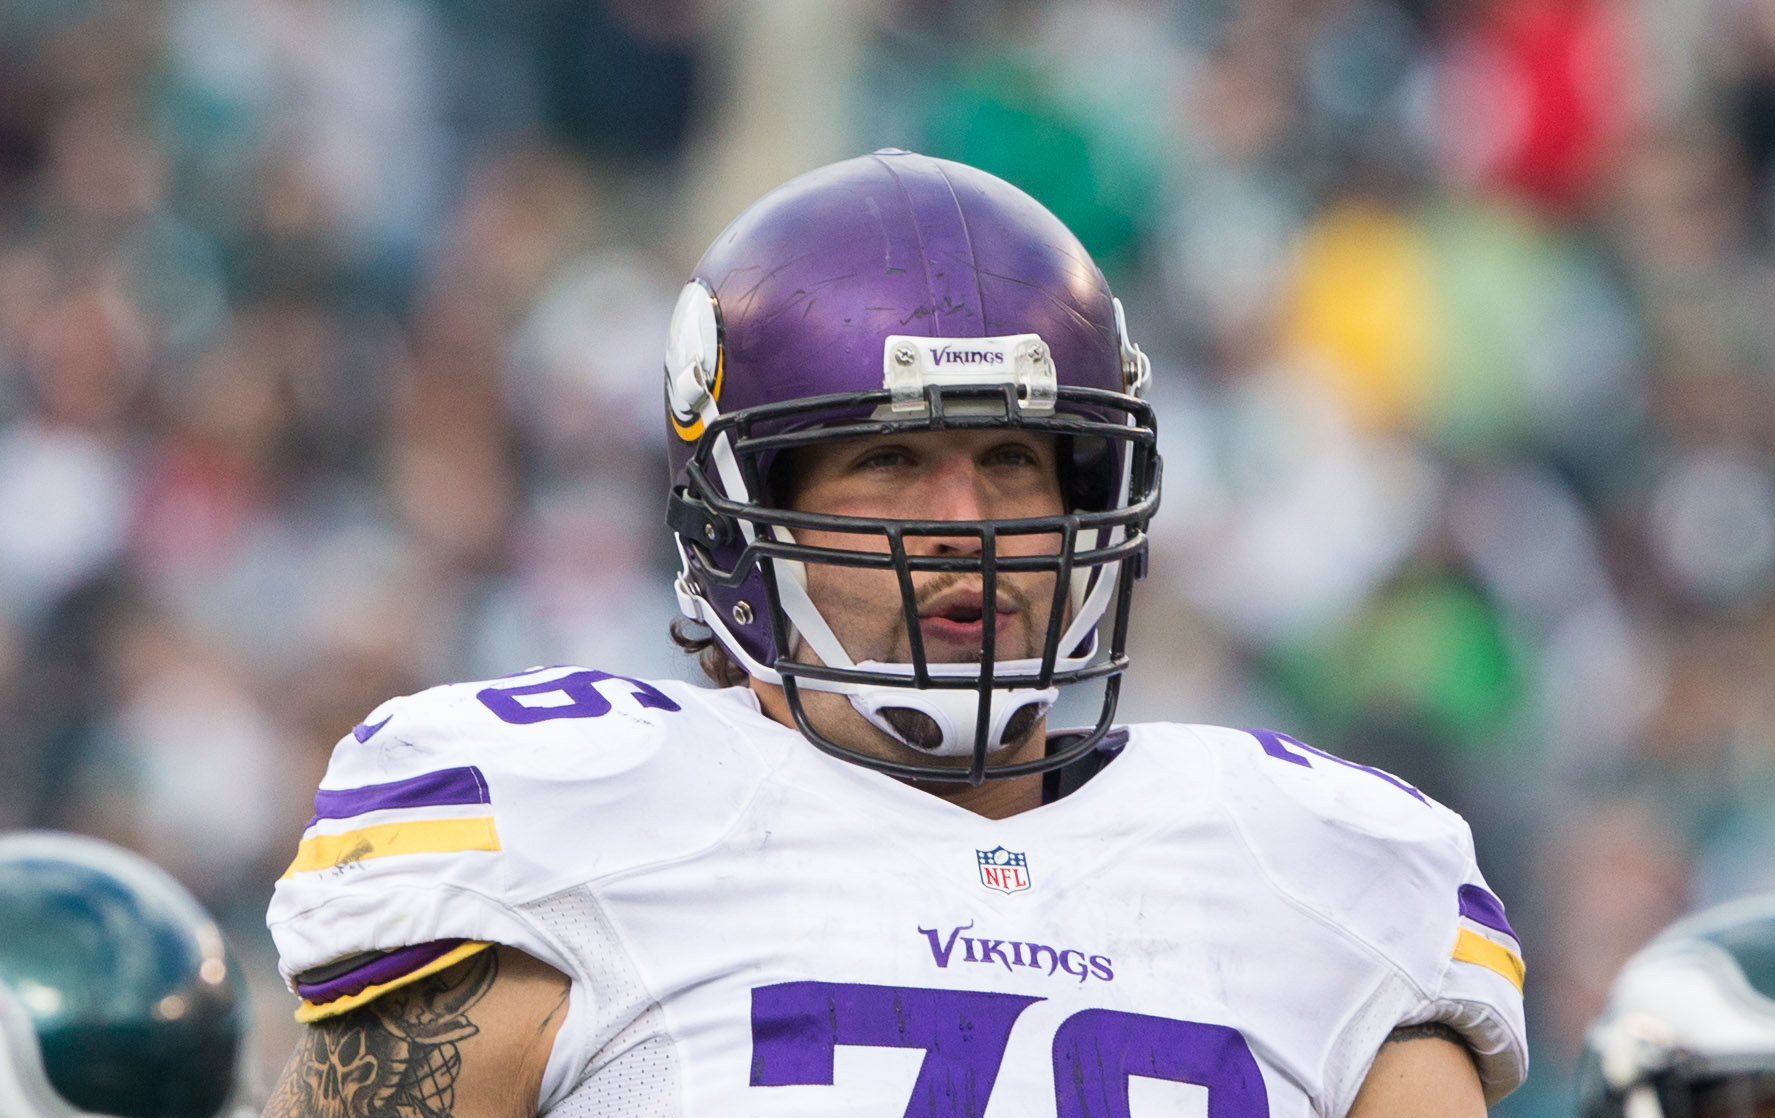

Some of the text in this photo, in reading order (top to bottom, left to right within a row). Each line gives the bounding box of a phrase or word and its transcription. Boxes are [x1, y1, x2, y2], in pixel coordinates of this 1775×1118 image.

[930, 345, 1004, 366] VIKINGS
[983, 867, 1027, 889] NFL
[917, 918, 1114, 984] VIKINGS
